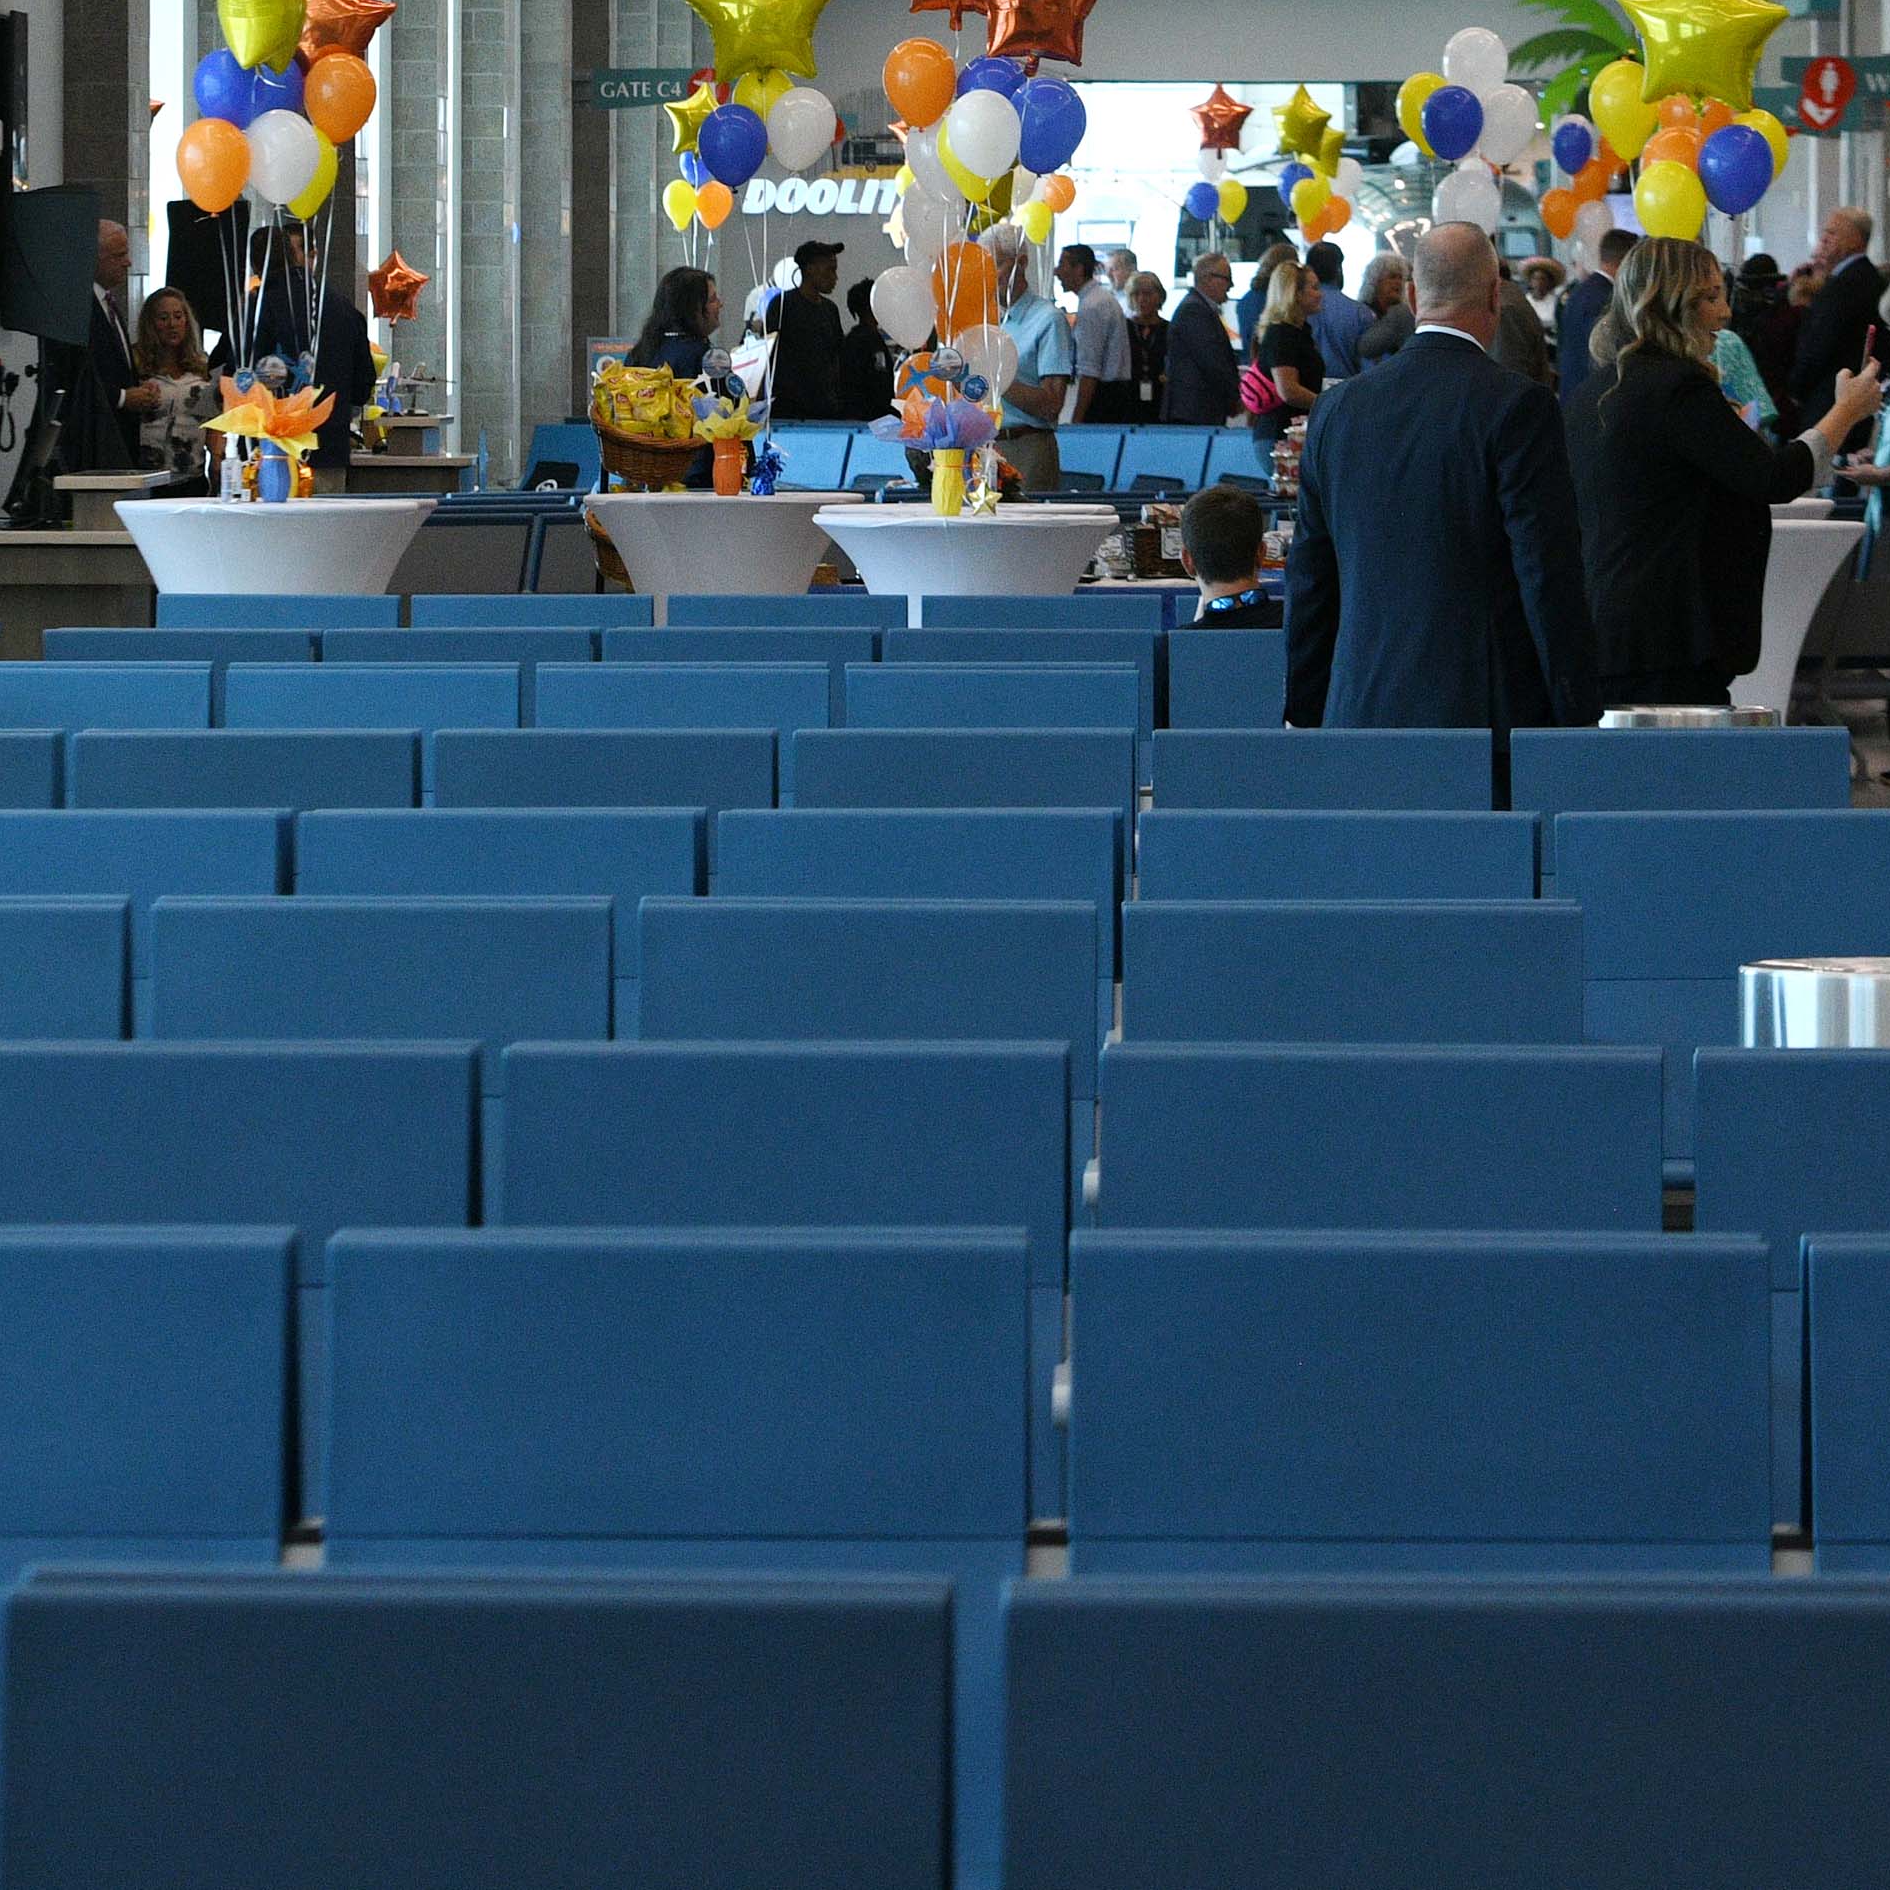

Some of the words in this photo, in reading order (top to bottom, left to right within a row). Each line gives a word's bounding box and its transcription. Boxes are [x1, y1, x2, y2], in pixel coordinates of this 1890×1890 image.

[599, 81, 652, 98] GATE
[657, 81, 682, 98] C4
[741, 177, 897, 215] DOOLIT
